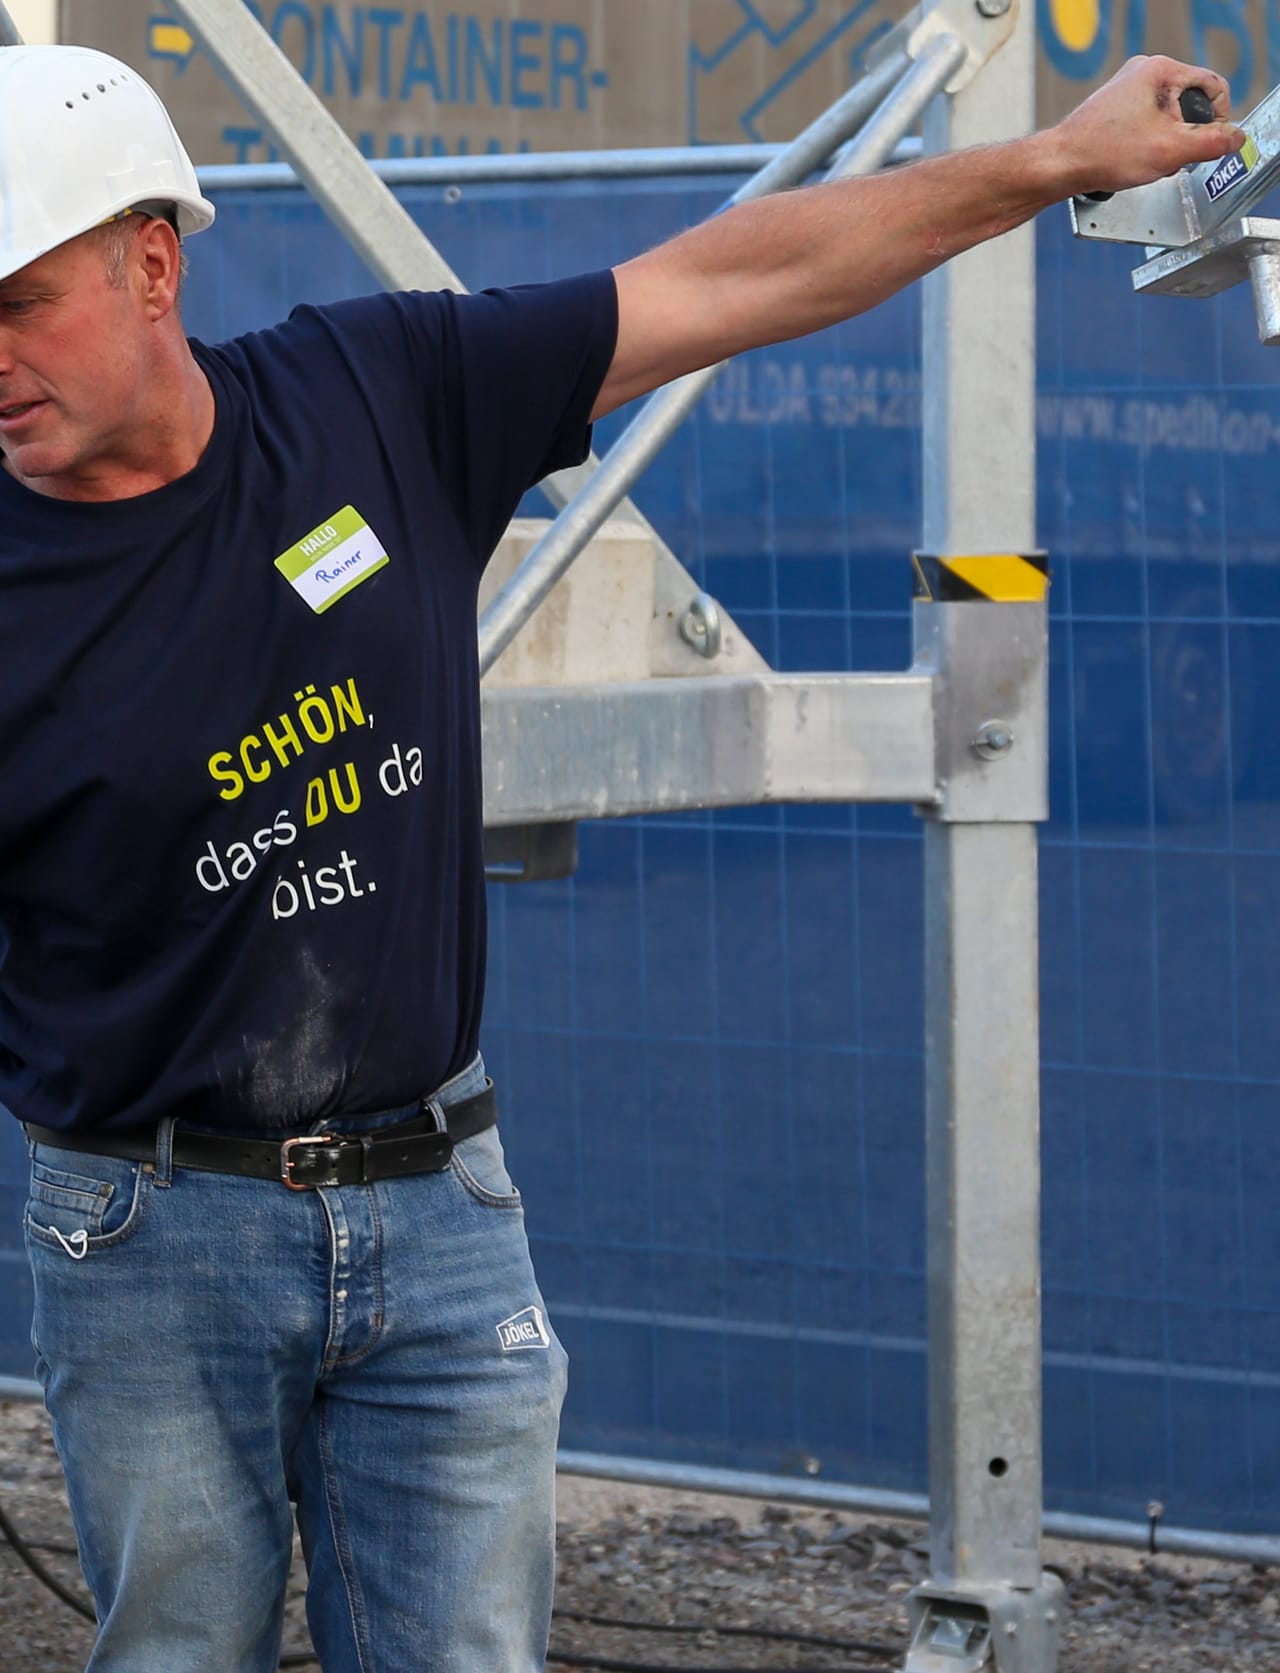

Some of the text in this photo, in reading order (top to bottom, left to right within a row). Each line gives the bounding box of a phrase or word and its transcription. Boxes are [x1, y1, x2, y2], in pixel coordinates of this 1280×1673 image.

[242, 0, 609, 110] ONTAINER-
[1209, 156, 1244, 195] JÖKEL
[299, 524, 338, 557] HALLO
[315, 550, 362, 584] Rainer
[207, 677, 374, 801] SCHÖN,
[195, 743, 424, 893] dass DU da
[504, 1322, 540, 1346] JÖKEL
